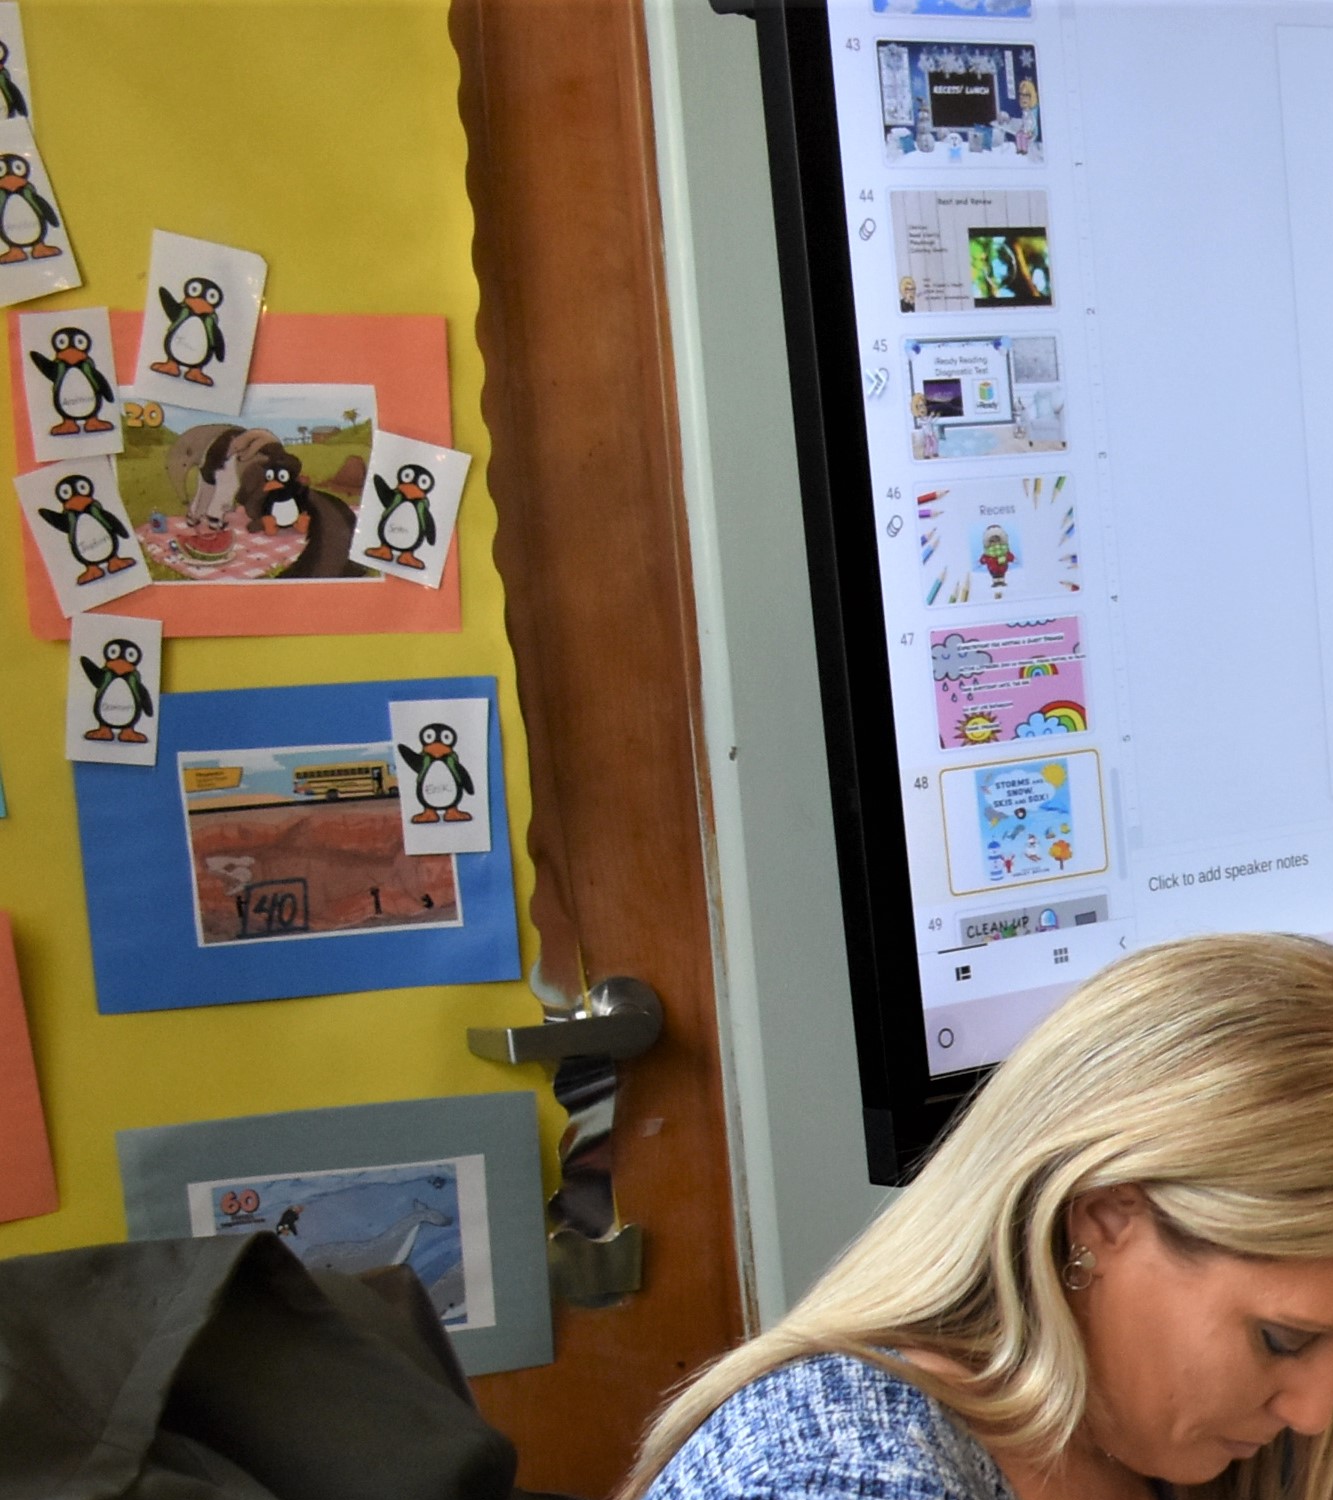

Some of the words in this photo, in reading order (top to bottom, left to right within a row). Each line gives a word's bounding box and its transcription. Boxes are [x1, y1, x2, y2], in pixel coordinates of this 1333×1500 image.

[845, 38, 861, 51] 43
[859, 189, 874, 202] 44
[873, 339, 888, 352] 45
[959, 356, 988, 366] Reading
[975, 366, 989, 376] Test
[124, 401, 165, 428] 20
[886, 487, 901, 500] 46
[979, 504, 1016, 516] Recess
[900, 632, 915, 646] 47
[914, 776, 929, 790] 48
[995, 778, 1030, 790] STORMS
[993, 797, 1012, 808] SKIS
[1148, 874, 1179, 892] Click
[1182, 872, 1195, 886] to
[1198, 866, 1222, 884] add
[1224, 860, 1273, 882] speaker
[1276, 854, 1309, 871] notes
[253, 891, 299, 932] 40
[928, 918, 943, 931] 49
[967, 921, 1006, 939] CLEAN
[1010, 915, 1030, 931] UP
[220, 1188, 261, 1216] 60
